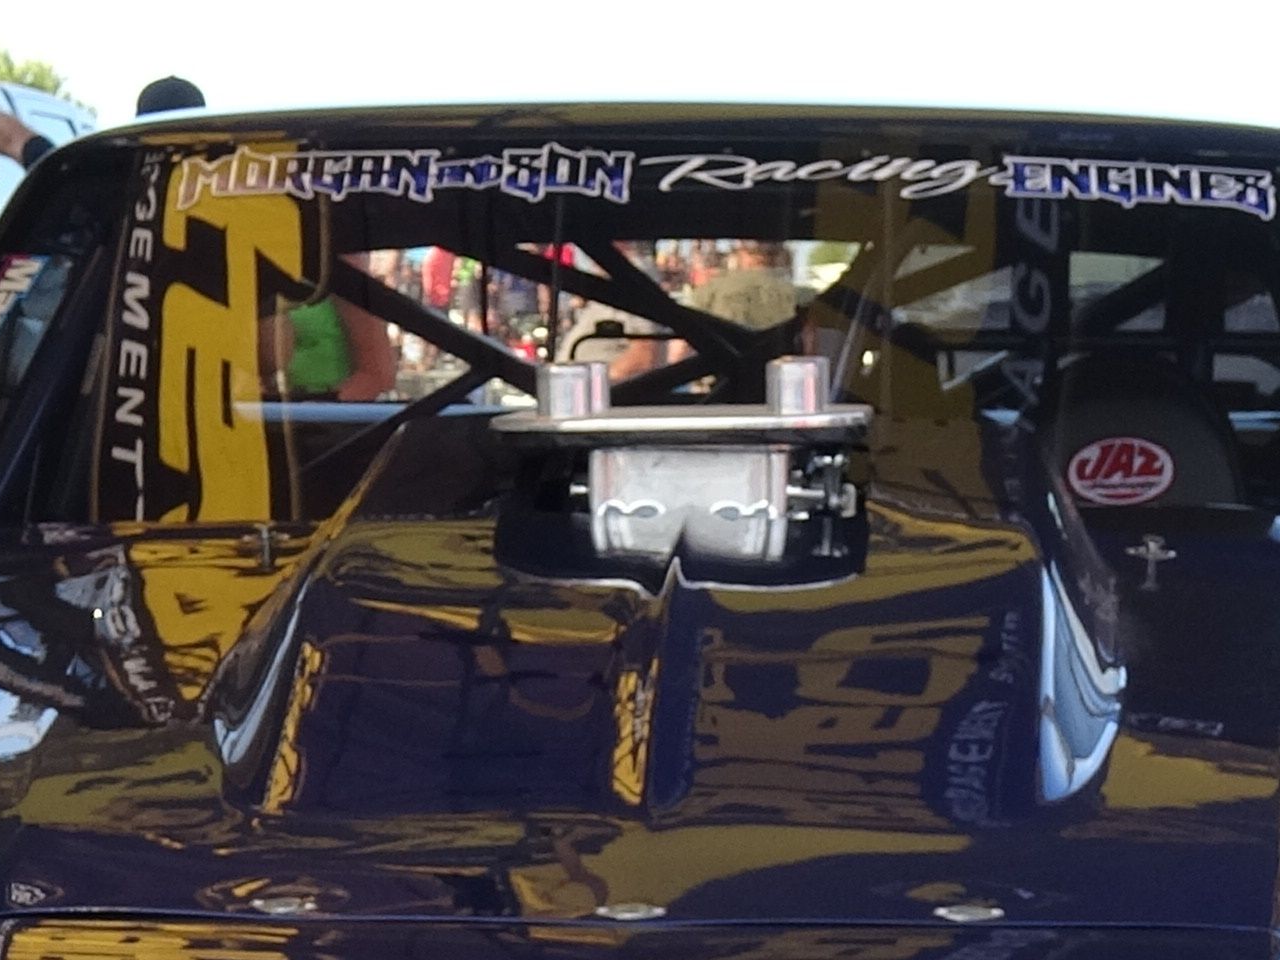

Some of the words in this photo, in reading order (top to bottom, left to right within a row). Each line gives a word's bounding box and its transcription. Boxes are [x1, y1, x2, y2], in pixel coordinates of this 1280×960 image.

[176, 145, 442, 210] MORGAN
[500, 142, 635, 203] SON
[640, 153, 1008, 199] Racing
[1000, 154, 1275, 220] ENGINES
[1075, 443, 1165, 481] JAZ
